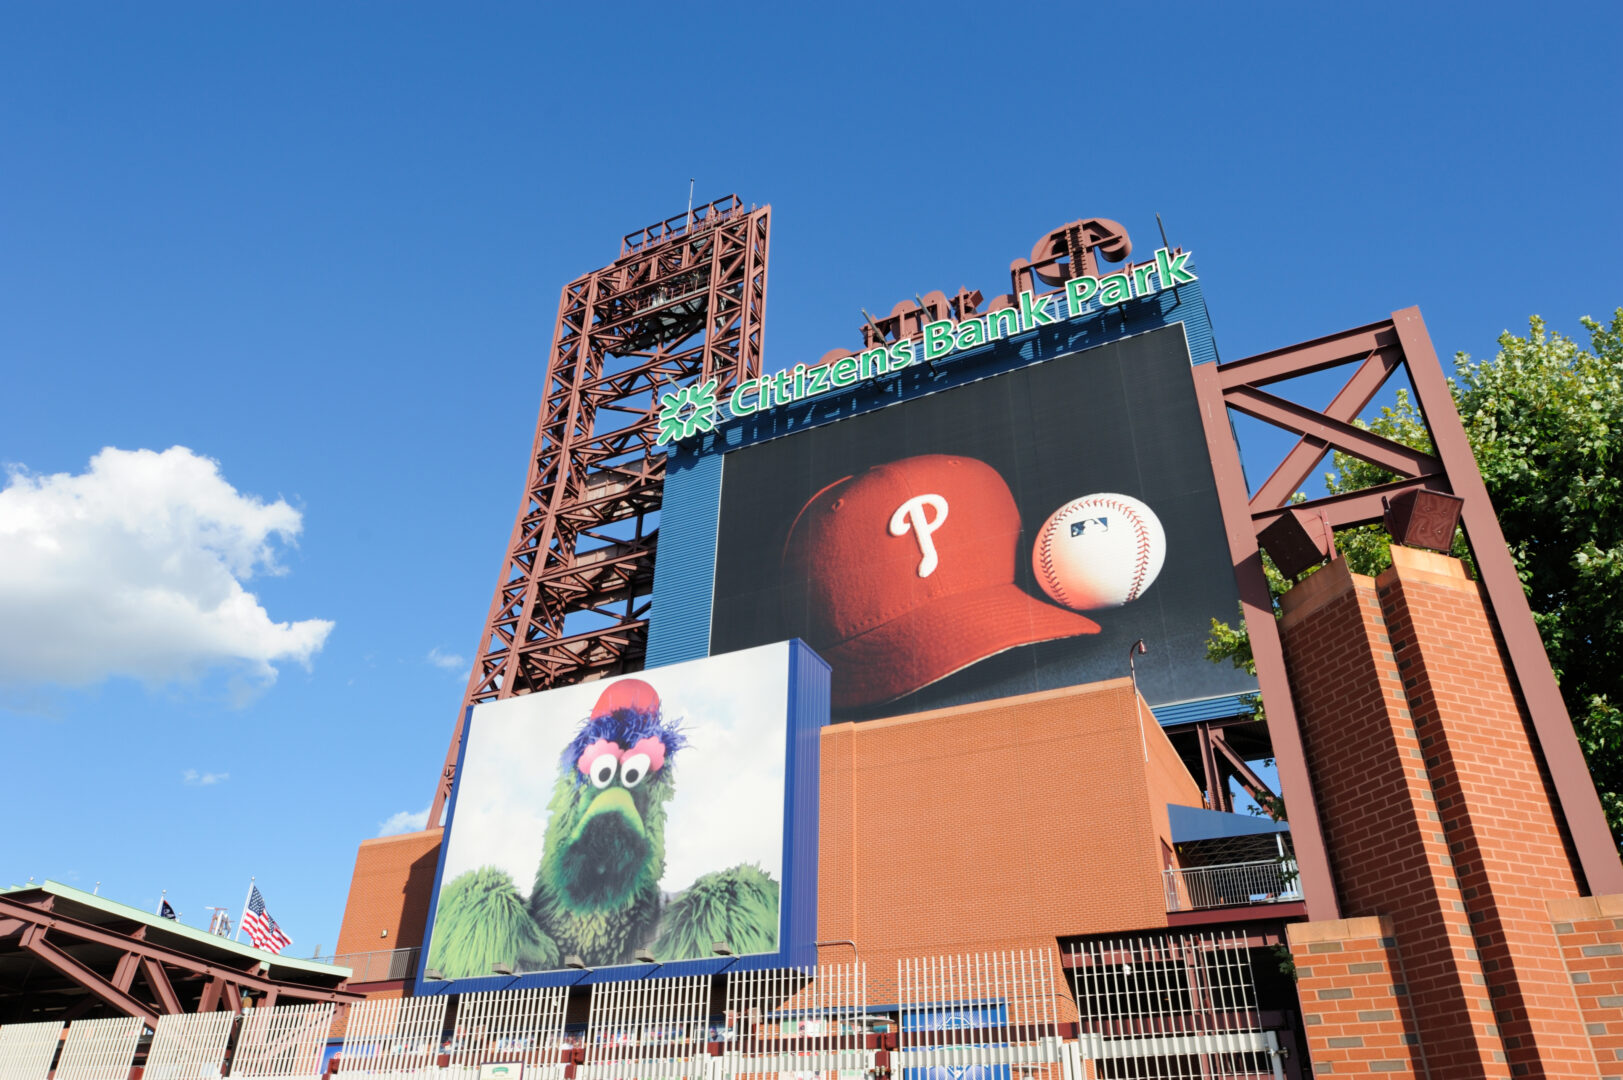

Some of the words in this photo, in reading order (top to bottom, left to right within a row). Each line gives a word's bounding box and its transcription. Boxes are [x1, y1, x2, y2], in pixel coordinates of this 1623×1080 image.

[729, 338, 914, 417] Citizens
[923, 290, 1054, 361] Bank
[1066, 247, 1198, 316] Park
[888, 493, 949, 578] P
